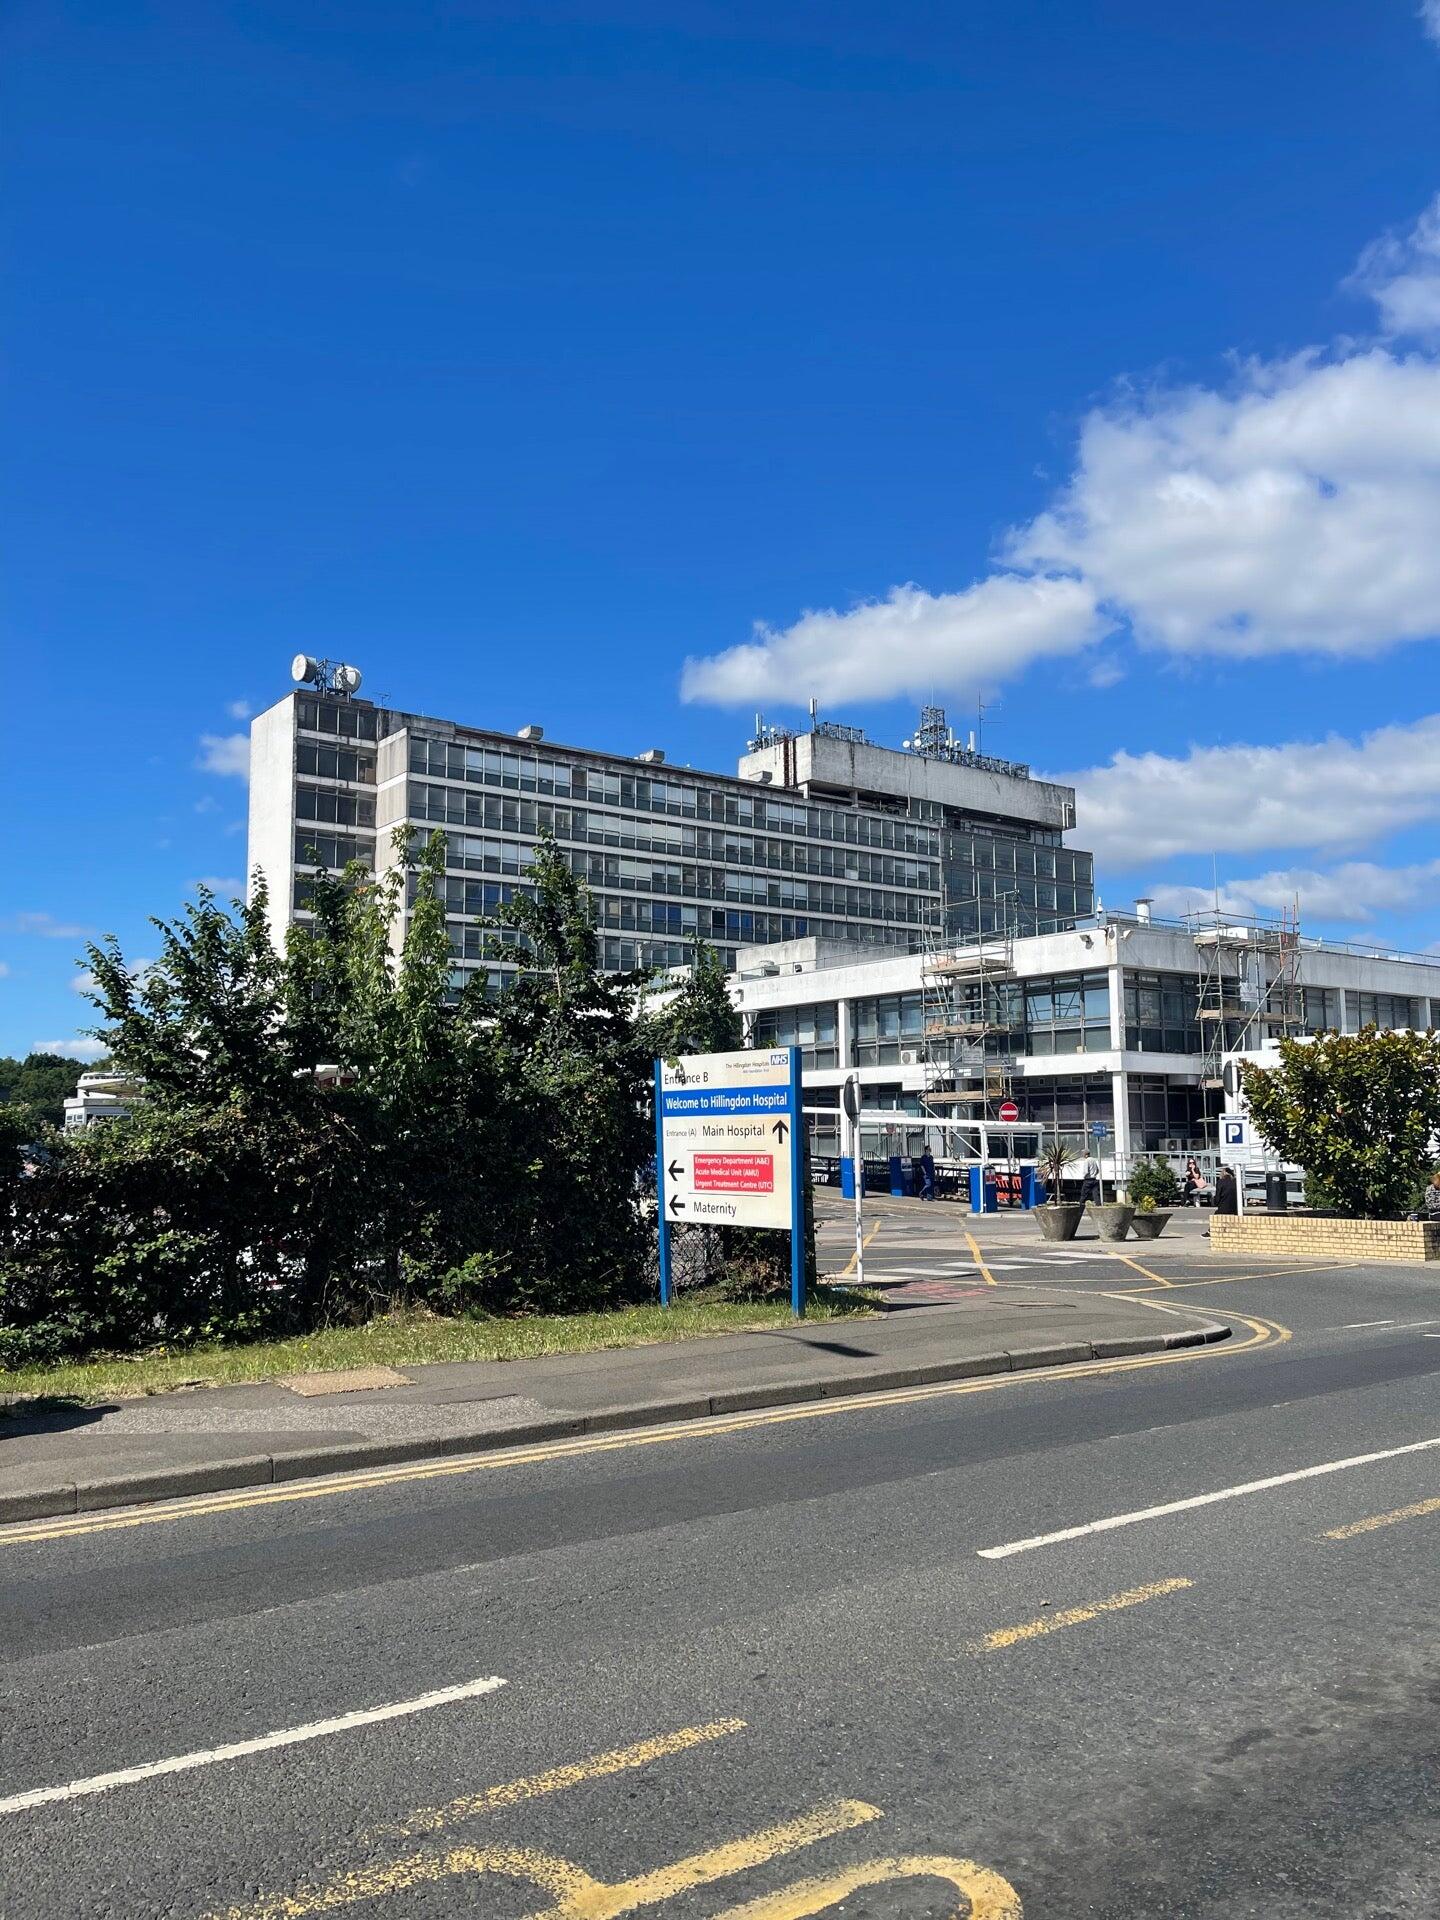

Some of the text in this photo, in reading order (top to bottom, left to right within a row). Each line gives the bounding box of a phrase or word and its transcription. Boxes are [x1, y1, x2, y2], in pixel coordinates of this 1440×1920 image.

[771, 1055, 788, 1065] NHS
[703, 1072, 709, 1082] B
[666, 1092, 787, 1110] Welcome to Hillingdon Hospital
[688, 1128, 697, 1137] (A)
[702, 1125, 724, 1137] Main
[727, 1124, 765, 1138] Hospital
[1228, 1125, 1240, 1142] P
[695, 1156, 770, 1165] Emergency Department (A&E)
[710, 1168, 730, 1176] Medical
[743, 1169, 759, 1177] (AMU)
[695, 1180, 712, 1188] Urgent
[713, 1180, 739, 1188] Treatment
[693, 1201, 736, 1217] Maternity
